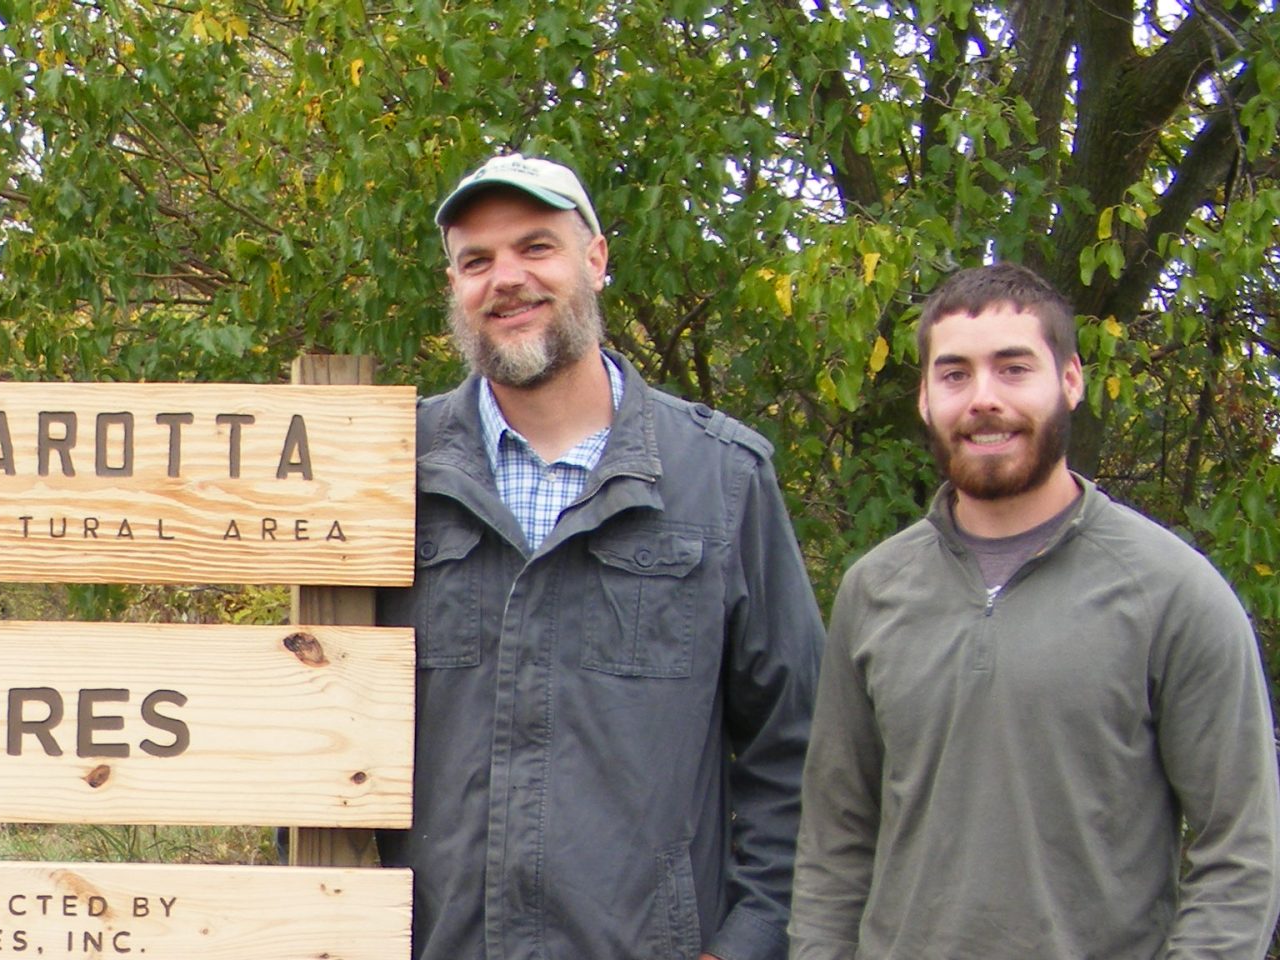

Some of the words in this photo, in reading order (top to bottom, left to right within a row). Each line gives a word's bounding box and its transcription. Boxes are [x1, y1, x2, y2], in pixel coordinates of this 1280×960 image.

[223, 518, 347, 542] AREA
[132, 897, 177, 918] BY
[66, 931, 147, 953] INC.
